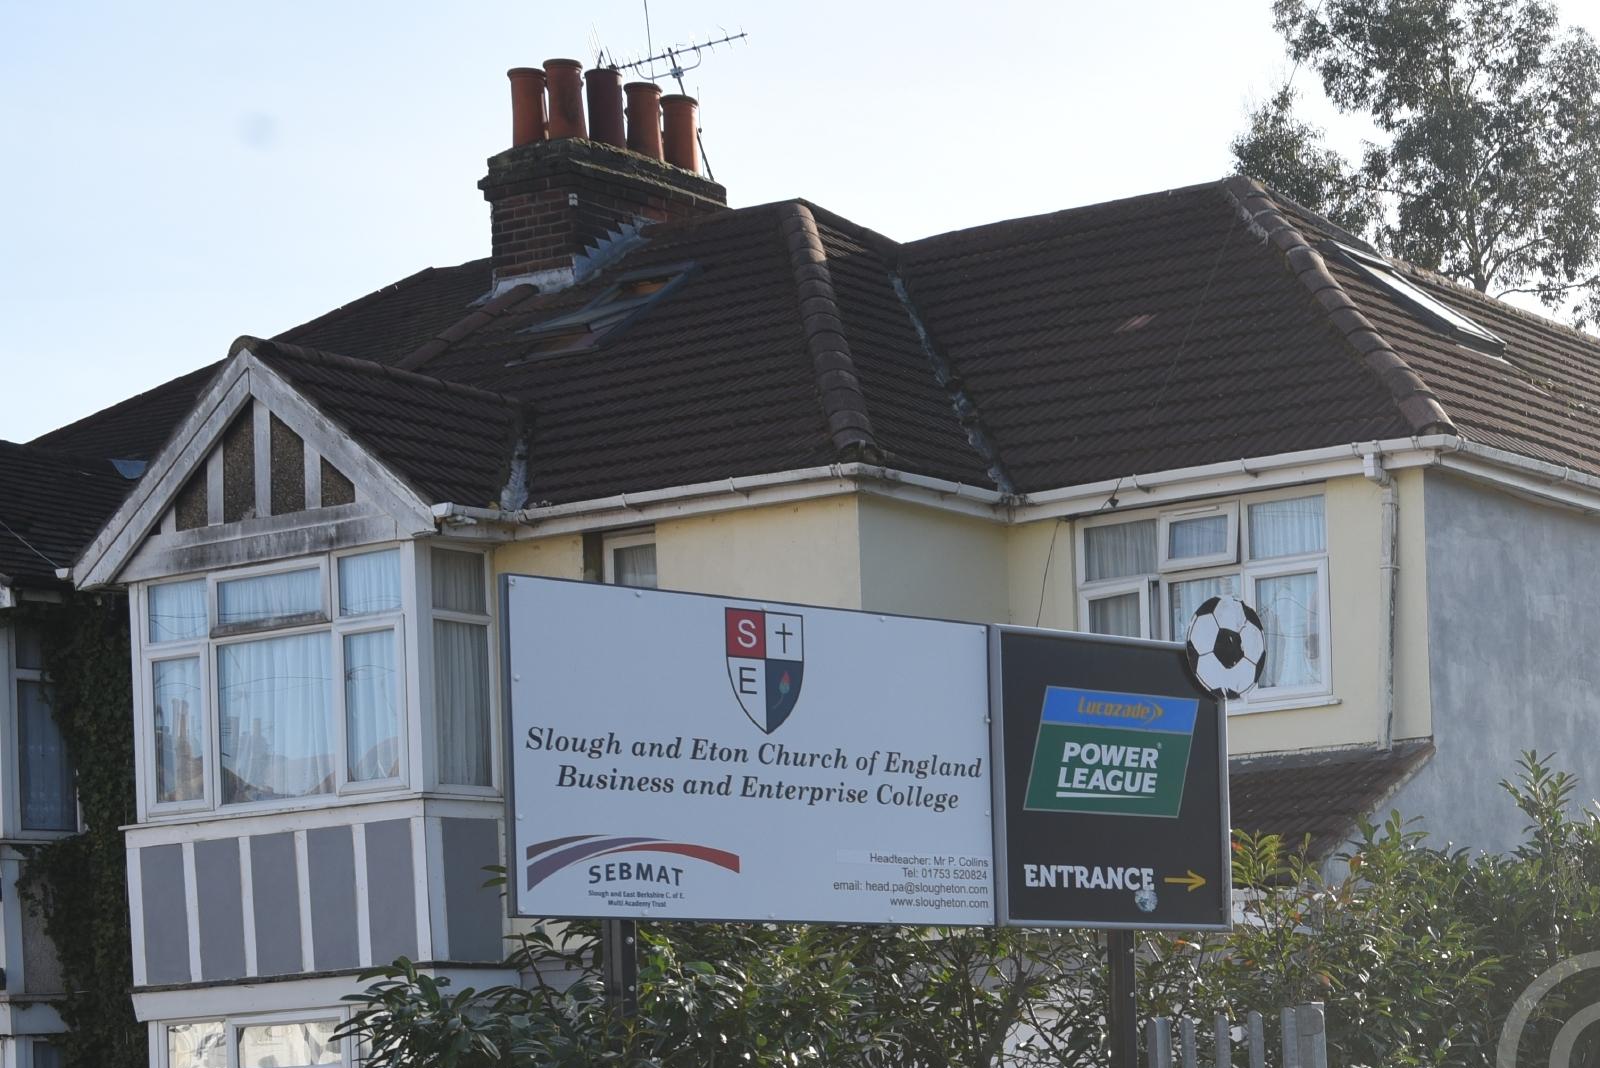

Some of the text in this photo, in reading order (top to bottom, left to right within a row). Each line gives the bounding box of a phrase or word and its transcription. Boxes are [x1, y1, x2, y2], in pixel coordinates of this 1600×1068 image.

[738, 618, 757, 649] S
[738, 666, 757, 695] E
[1077, 696, 1150, 719] Lucozade
[525, 726, 983, 779] Slough and Eton Church of England
[1061, 741, 1159, 769] POWER
[555, 764, 959, 813] Business and Enterprise College
[1057, 766, 1158, 793] LEAGUE
[869, 852, 989, 868] Headteacher: Mr P. Collins
[588, 862, 684, 887] SEBMAT
[901, 867, 988, 880] Tel: 01753 520824
[1023, 864, 1156, 891] ENTRANCE
[588, 889, 610, 898] Slough
[610, 890, 622, 898] and
[636, 891, 665, 899] Berkshire
[833, 880, 989, 895] email: head.pa@slougheton.com
[624, 899, 651, 908] Academy
[652, 900, 667, 908] Trust
[889, 897, 989, 909] www.slougheton.com
